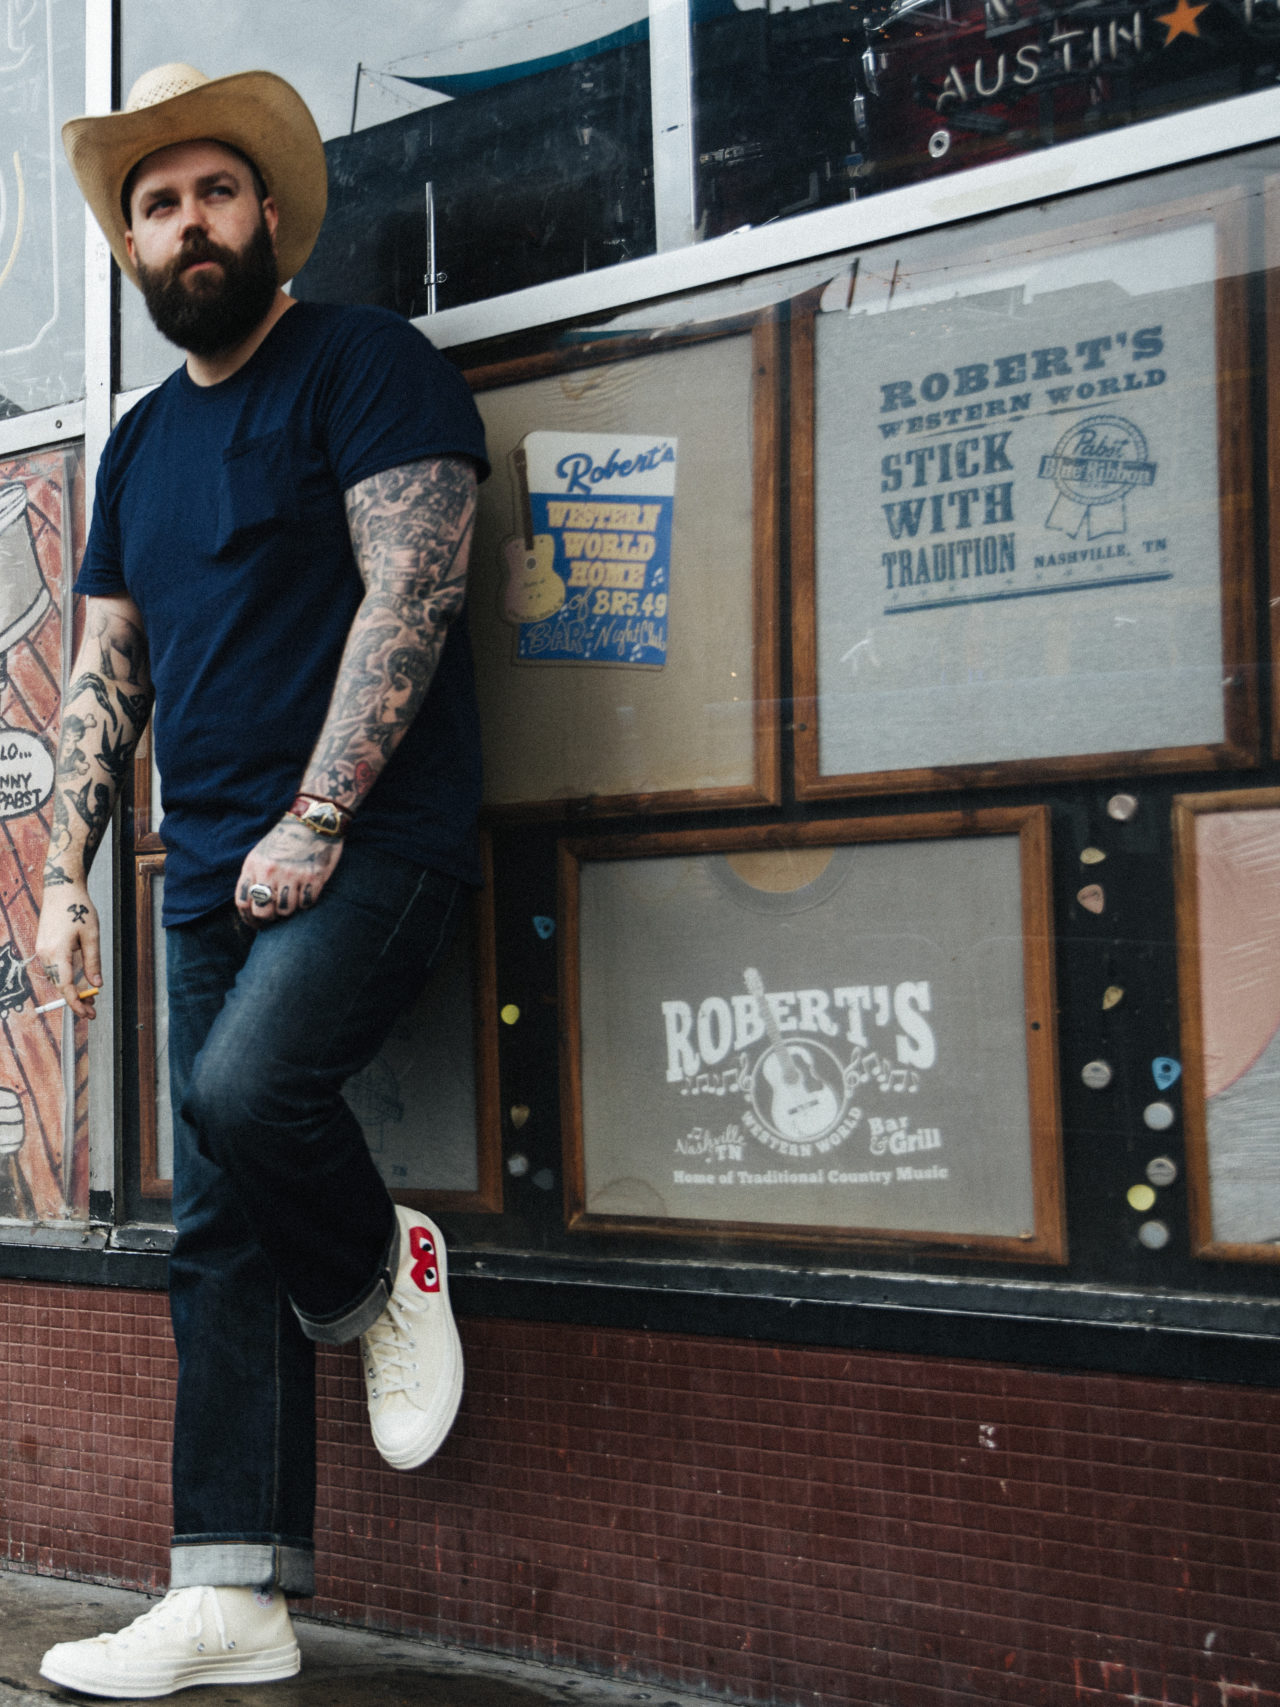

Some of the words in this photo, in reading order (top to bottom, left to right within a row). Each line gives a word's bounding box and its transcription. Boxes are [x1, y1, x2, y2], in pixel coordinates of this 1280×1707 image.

[936, 11, 1143, 111] AUSTIN
[879, 325, 1165, 413] ROBERT'S
[878, 392, 1032, 440] WESTERN
[1046, 368, 1167, 406] WORLD
[1073, 428, 1129, 458] Pabst
[881, 430, 1014, 494] STICK
[547, 501, 662, 532] WESTERN
[881, 480, 1015, 540] WITH
[562, 532, 657, 562] WORLD
[882, 532, 1016, 590] TRADITION
[1142, 537, 1168, 554] TN
[567, 561, 647, 589] HOME
[661, 981, 937, 1082] ROBERT'S
[740, 1110, 811, 1158] WESTERN
[816, 1106, 863, 1154] WORLD
[867, 1115, 909, 1137] Bar
[888, 1127, 943, 1155] Grill
[715, 1143, 743, 1161] TN
[673, 1169, 716, 1184] Home
[718, 1169, 735, 1184] of
[737, 1168, 824, 1184] Traditional
[827, 1169, 893, 1185] Country
[896, 1165, 949, 1181] Music
